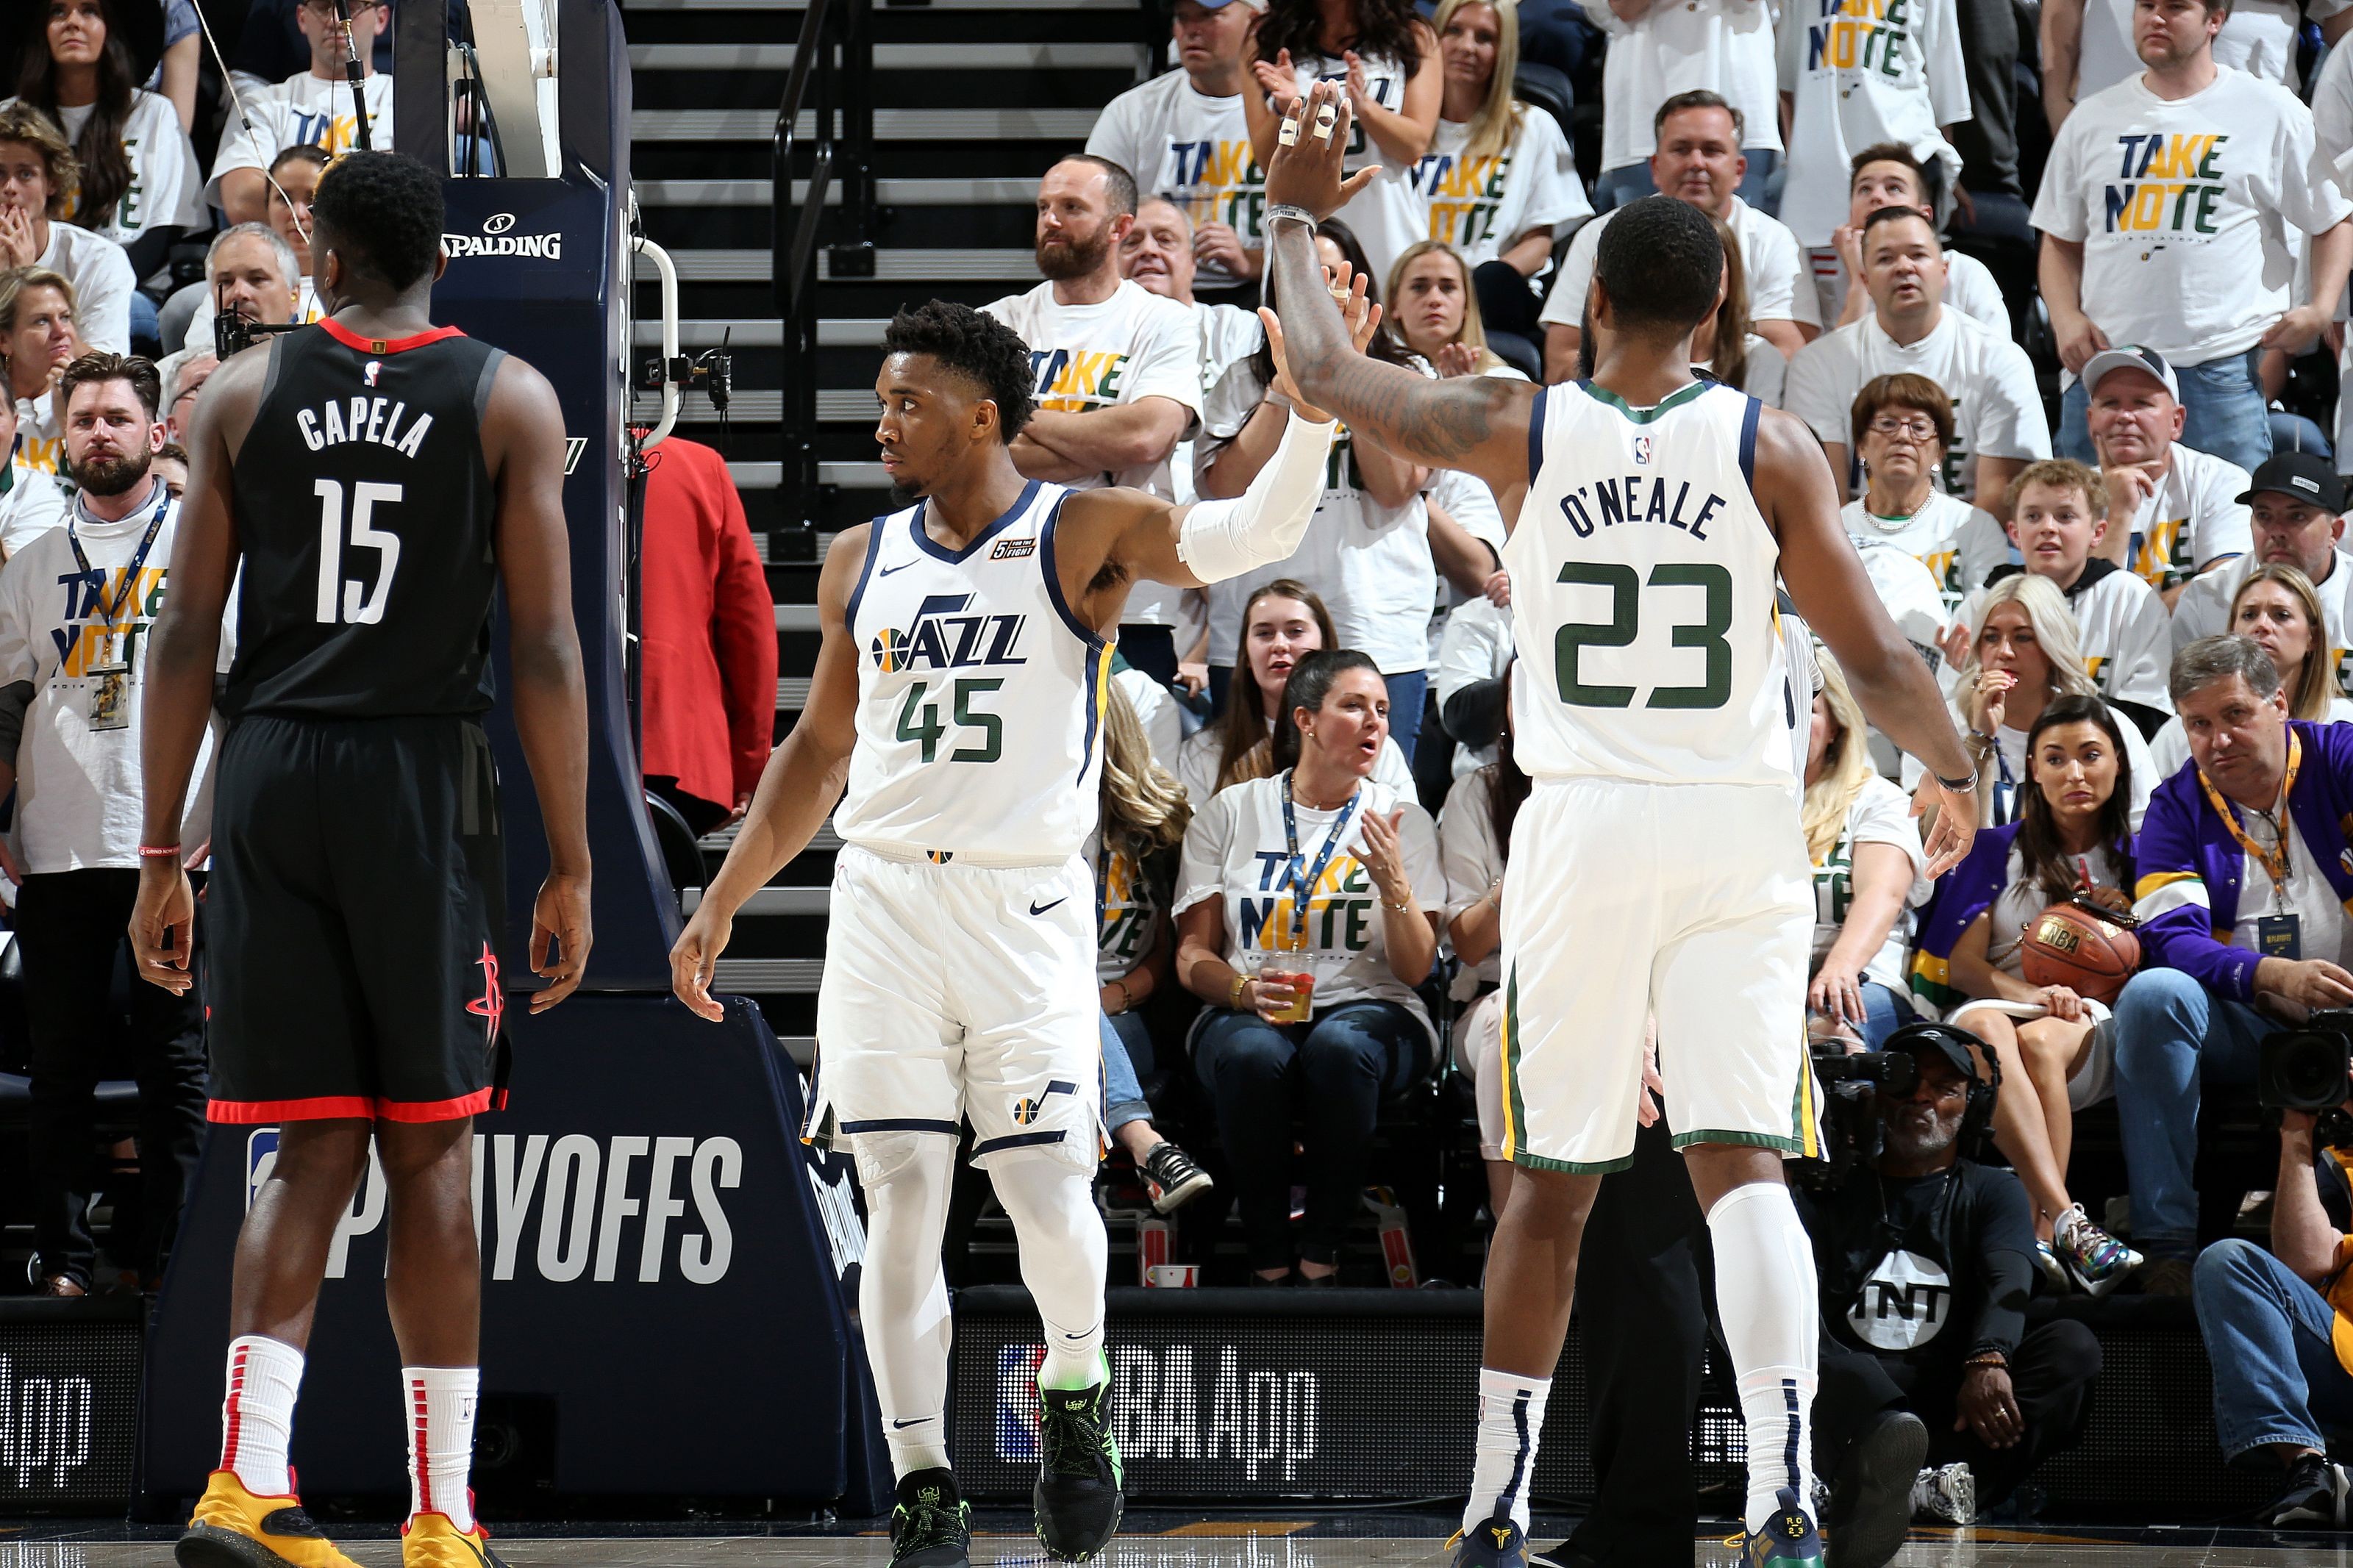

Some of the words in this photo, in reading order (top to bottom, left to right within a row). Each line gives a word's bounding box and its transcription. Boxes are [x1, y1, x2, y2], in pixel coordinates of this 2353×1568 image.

[1809, 22, 1907, 77] NOTE
[2118, 134, 2229, 179] TAKE
[1161, 190, 1267, 237] OTE
[1429, 201, 1499, 246] OTE
[2105, 185, 2225, 234] NOTE
[440, 232, 561, 260] SPALDING
[296, 397, 433, 459] CAPELA
[1560, 476, 1727, 541] O'NEALE
[314, 479, 402, 624] 15
[993, 542, 1008, 559] 5
[1006, 548, 1033, 557] FIGHT
[2127, 518, 2194, 578] AKE
[51, 624, 153, 679] NOT
[1555, 562, 1732, 709] 23
[896, 678, 1004, 764] 45
[1256, 851, 1371, 896] TAKE
[1240, 898, 1373, 951] NOTE
[2046, 925, 2081, 954] NBA
[324, 1134, 743, 1285] PYOFFS
[1104, 1345, 1201, 1459] BA
[1207, 1345, 1321, 1481] App
